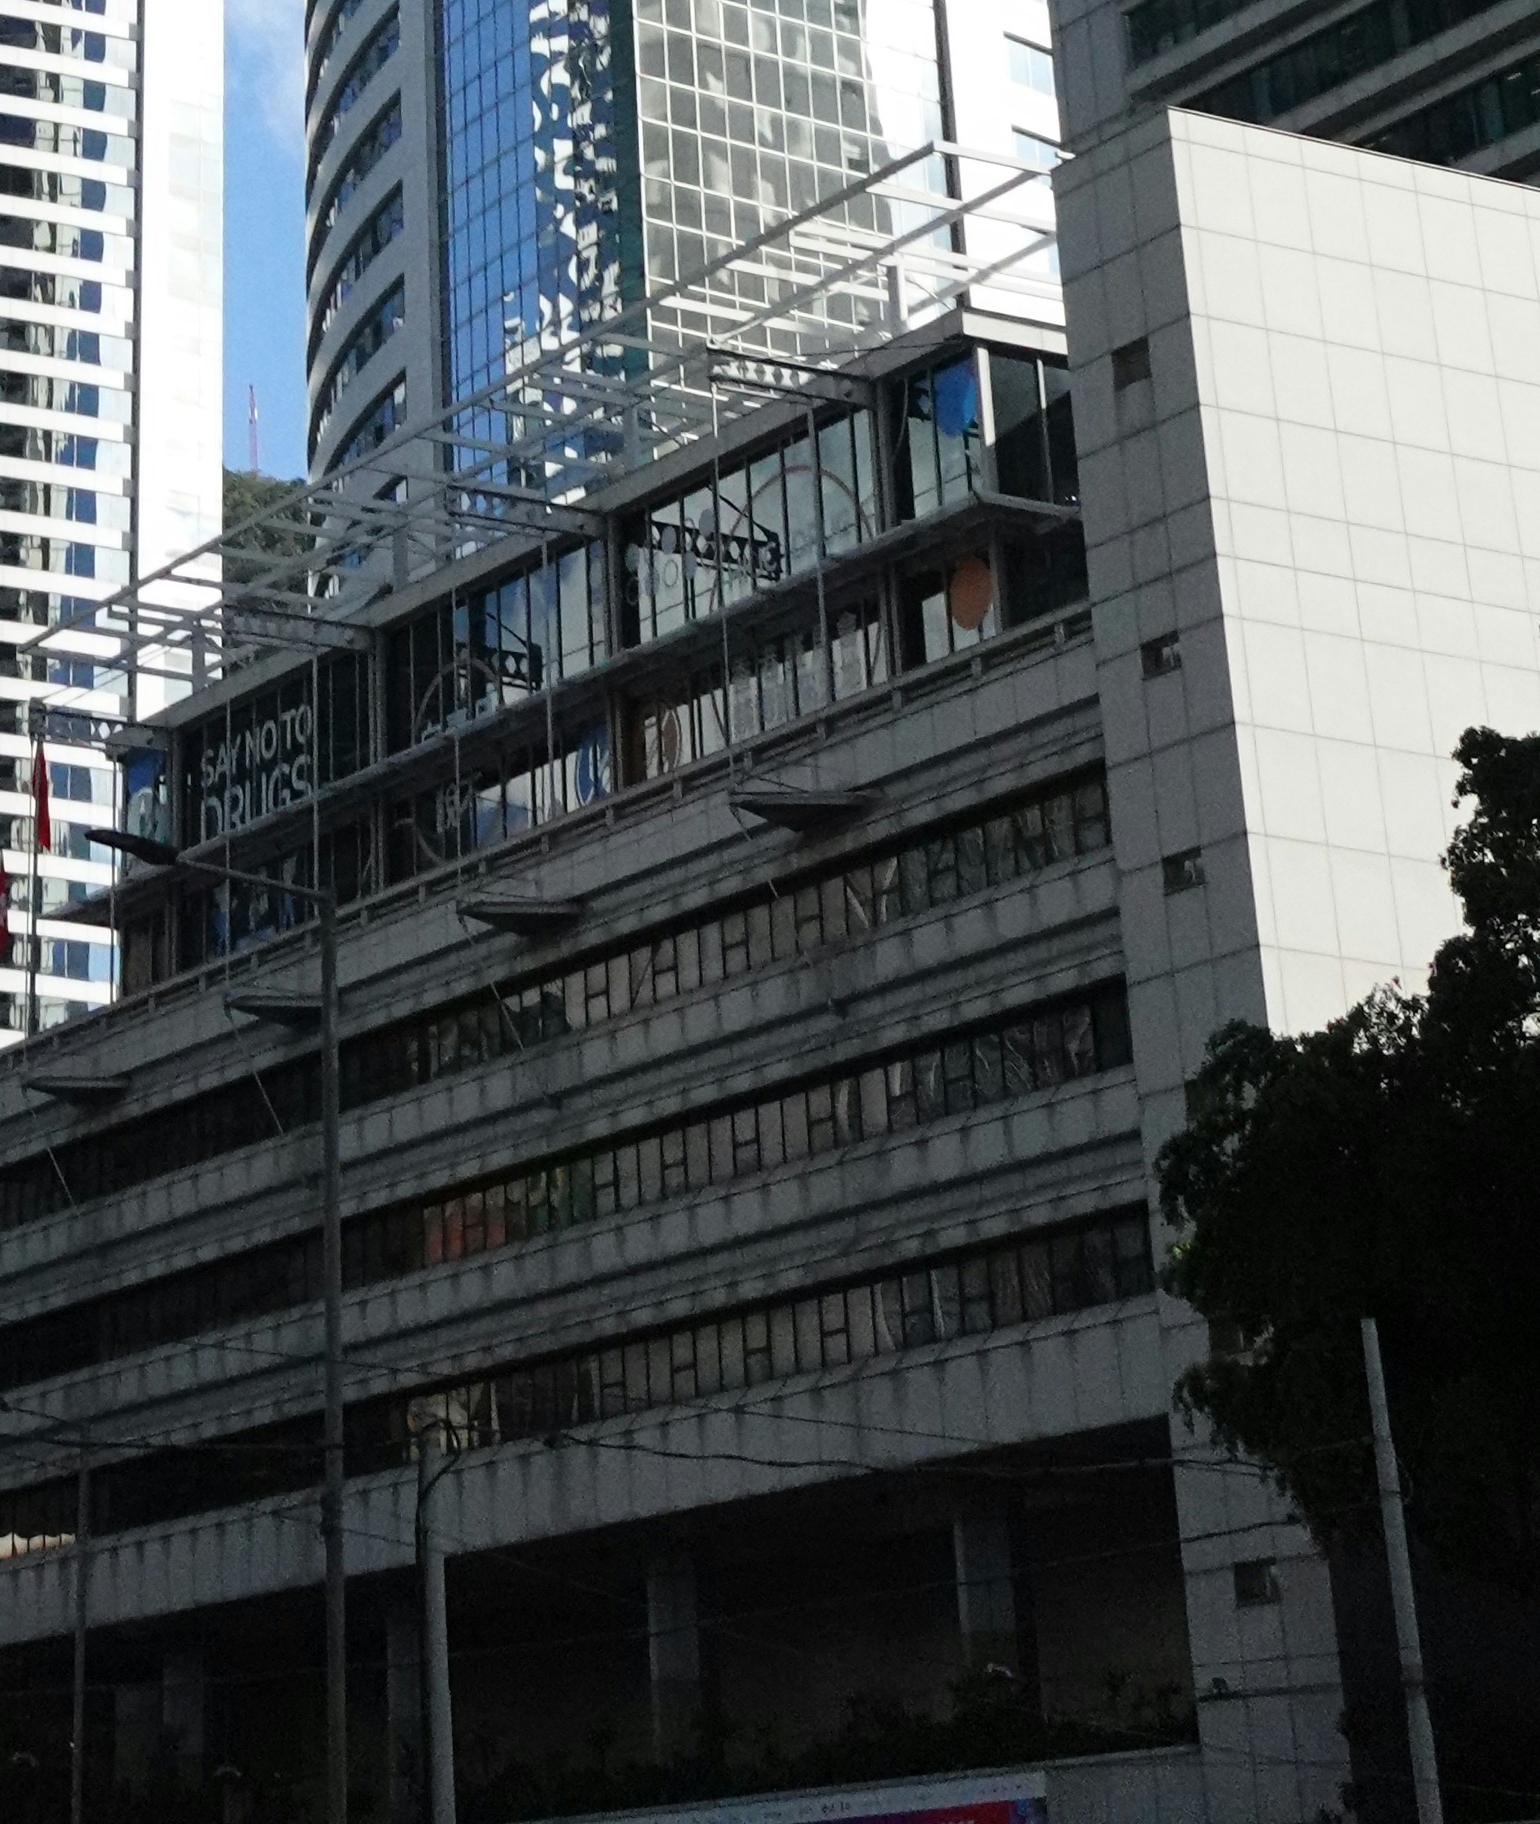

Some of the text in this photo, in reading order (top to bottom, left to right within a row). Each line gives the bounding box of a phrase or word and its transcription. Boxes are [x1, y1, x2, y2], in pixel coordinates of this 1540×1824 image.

[200, 702, 313, 788] SAY NO TO
[200, 753, 313, 842] DRUGS
